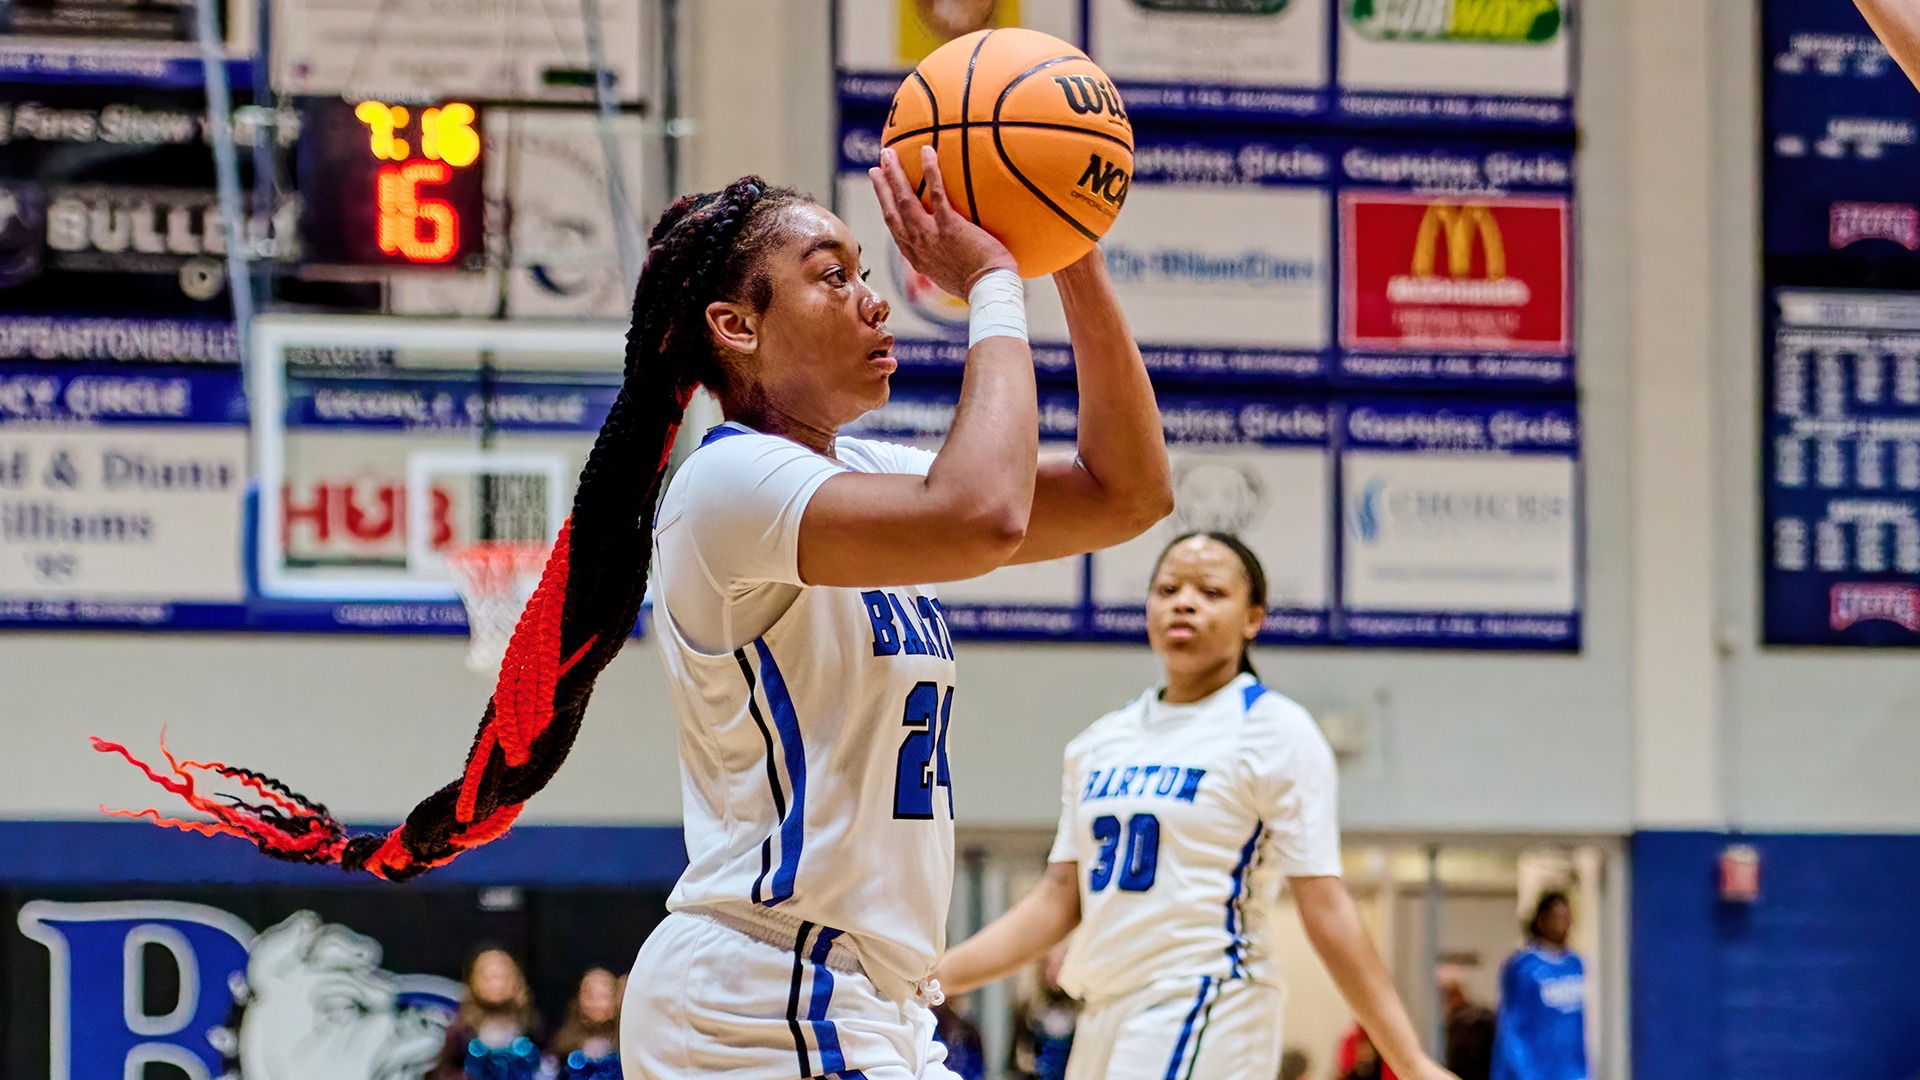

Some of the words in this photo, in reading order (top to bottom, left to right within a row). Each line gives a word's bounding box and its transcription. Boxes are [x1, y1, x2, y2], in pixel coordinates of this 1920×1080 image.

[1052, 75, 1130, 124] Wil
[1077, 153, 1130, 210] NCA
[378, 160, 460, 262] 16
[2, 500, 154, 542] illiams
[1089, 813, 1160, 892] 30
